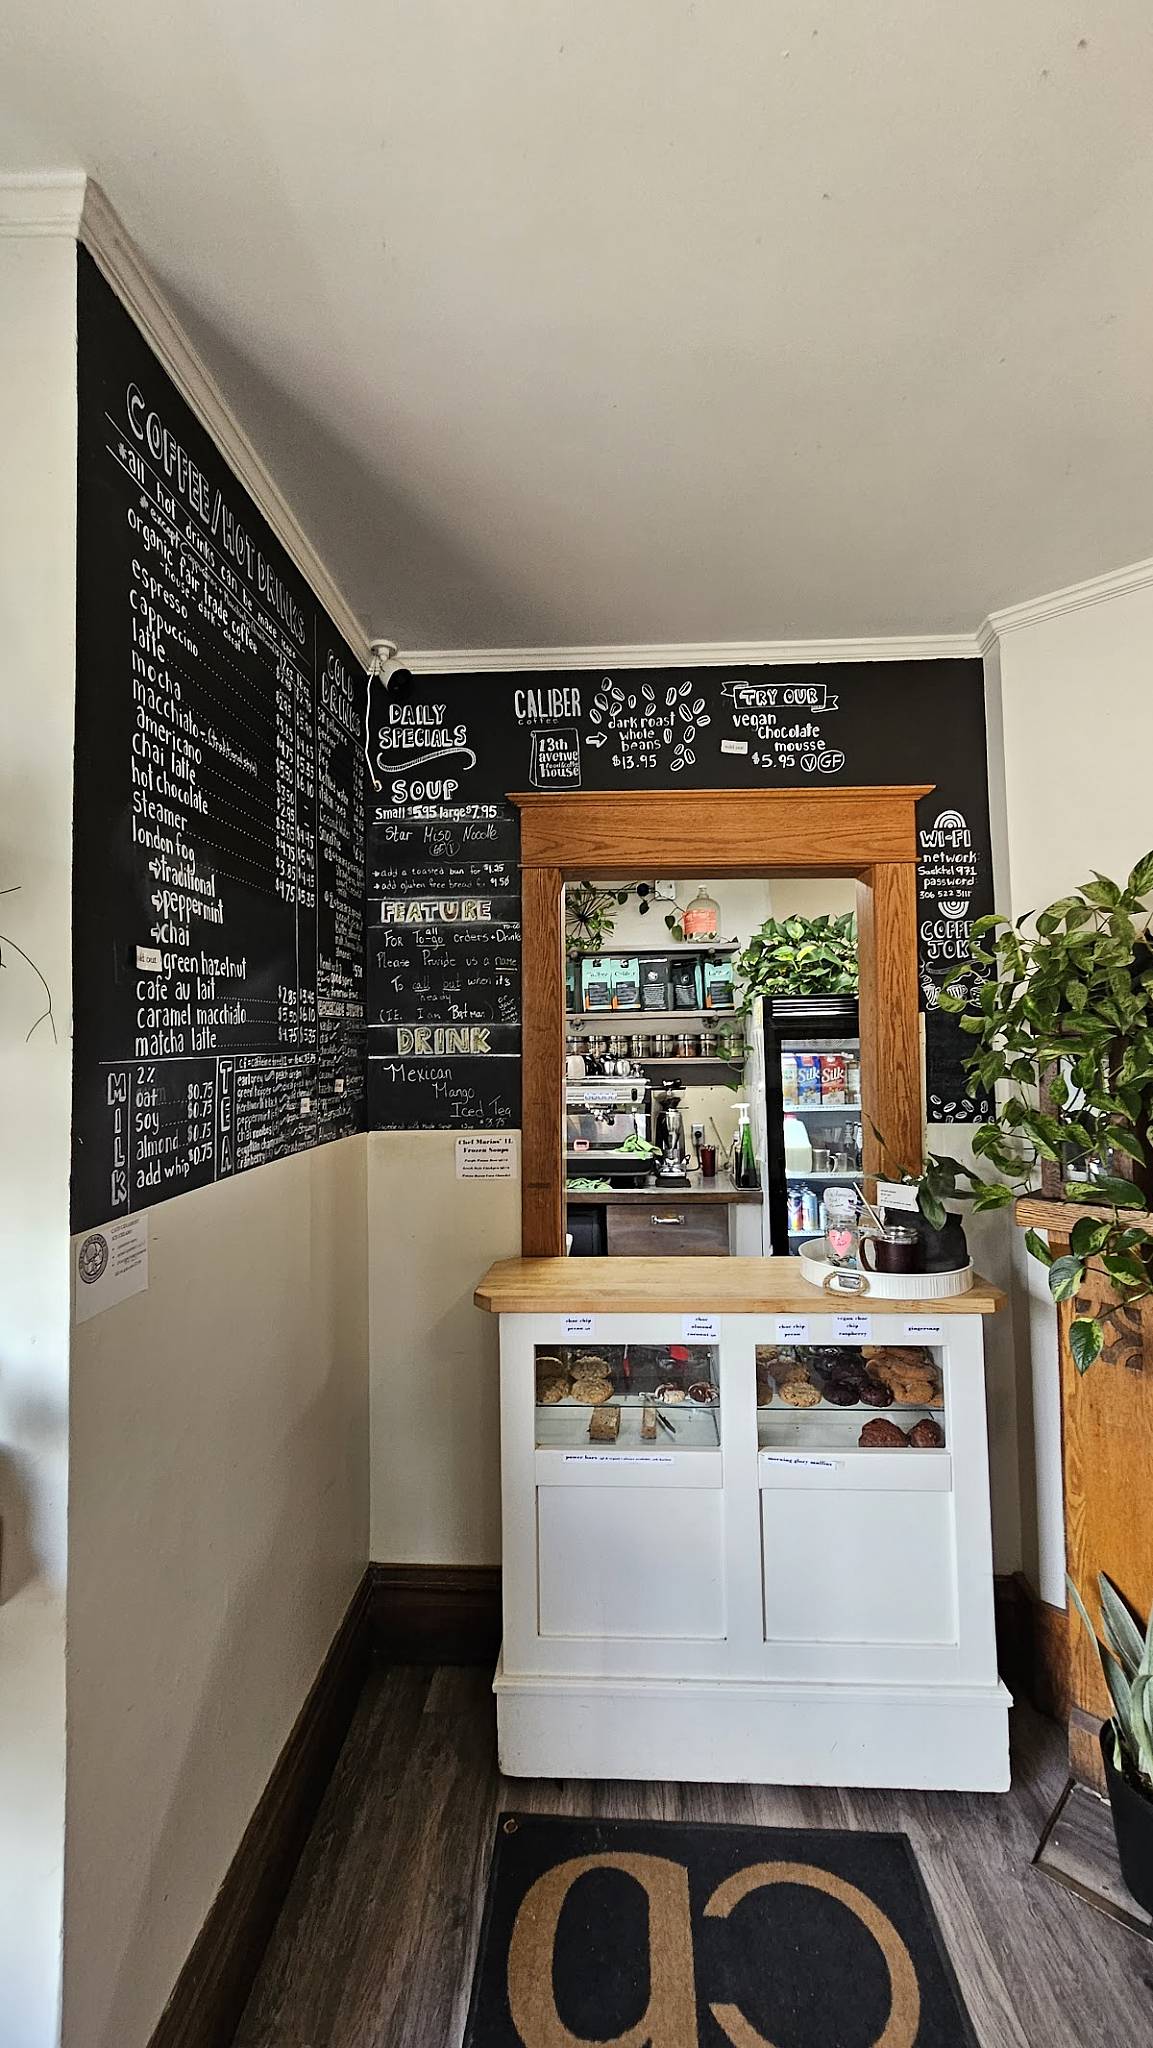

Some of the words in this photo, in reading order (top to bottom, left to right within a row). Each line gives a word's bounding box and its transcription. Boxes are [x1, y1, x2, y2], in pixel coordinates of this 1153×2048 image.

[157, 482, 176, 520] hot
[186, 520, 215, 568] drinks
[221, 566, 237, 594] can
[243, 588, 253, 612] be
[258, 612, 278, 639] made
[127, 508, 173, 566] organic
[180, 556, 200, 593] fair
[204, 581, 228, 625] trade
[232, 621, 257, 655] coffee
[132, 559, 188, 619] espresso
[258, 551, 305, 645] DRINKS
[132, 617, 165, 663] latte
[132, 650, 181, 701] mocha
[514, 688, 582, 718] CALIBER
[739, 688, 778, 706] TRY
[783, 687, 819, 704] OUR
[133, 679, 199, 738] macchiato
[389, 703, 447, 725] DAILY
[608, 715, 638, 729] dark
[640, 711, 676, 728] roast
[619, 728, 655, 741] whole
[732, 714, 777, 732] vegan
[136, 705, 202, 765] americano
[378, 725, 467, 749] SPECIALS
[539, 738, 568, 752] 13th
[621, 739, 661, 752] beans
[774, 740, 826, 752] mousse
[539, 750, 579, 763] avenue
[612, 754, 657, 769] $13.95
[751, 752, 796, 768] $5.95
[171, 751, 196, 786] latte
[539, 763, 580, 778] house
[132, 755, 153, 792] hot
[156, 771, 209, 815] chocolate
[391, 779, 459, 804] SOUP
[375, 807, 405, 820] Small
[439, 807, 466, 822] large
[465, 805, 498, 819] $7.95
[385, 825, 413, 842] Star
[920, 829, 971, 848] WI-FI
[132, 815, 174, 856] london
[175, 832, 195, 876] fog
[162, 854, 215, 898] traditional
[956, 866, 977, 875] 971
[924, 876, 974, 889] password
[920, 891, 935, 899] 306
[163, 890, 224, 924] peppermint
[381, 900, 492, 924] FEATURE
[163, 953, 199, 980] green
[201, 950, 247, 980] hazelnut
[175, 981, 190, 1000] au
[197, 976, 216, 1000] lait
[391, 974, 404, 993] To
[137, 1003, 191, 1028] caramel
[196, 1001, 246, 1025] macchiato
[417, 1008, 424, 1019] I
[135, 1028, 184, 1056] matcha
[191, 1026, 217, 1051] latte
[397, 1026, 492, 1055] DRINK
[136, 1066, 156, 1084] 2%
[383, 1063, 453, 1082] Mexican
[798, 1066, 820, 1083] Silk
[822, 1067, 844, 1083] Silk
[135, 1088, 158, 1108] oat
[187, 1081, 214, 1100] $0.75
[432, 1082, 475, 1104] Mango
[135, 1112, 159, 1135] soy
[187, 1099, 213, 1119] $0.75
[450, 1100, 484, 1118] Iced
[489, 1095, 512, 1117] Tea
[136, 1129, 179, 1161] almond
[187, 1122, 212, 1144] $0.75
[136, 1158, 161, 1189] add
[164, 1156, 190, 1178] whip
[188, 1142, 213, 1165] $0.75
